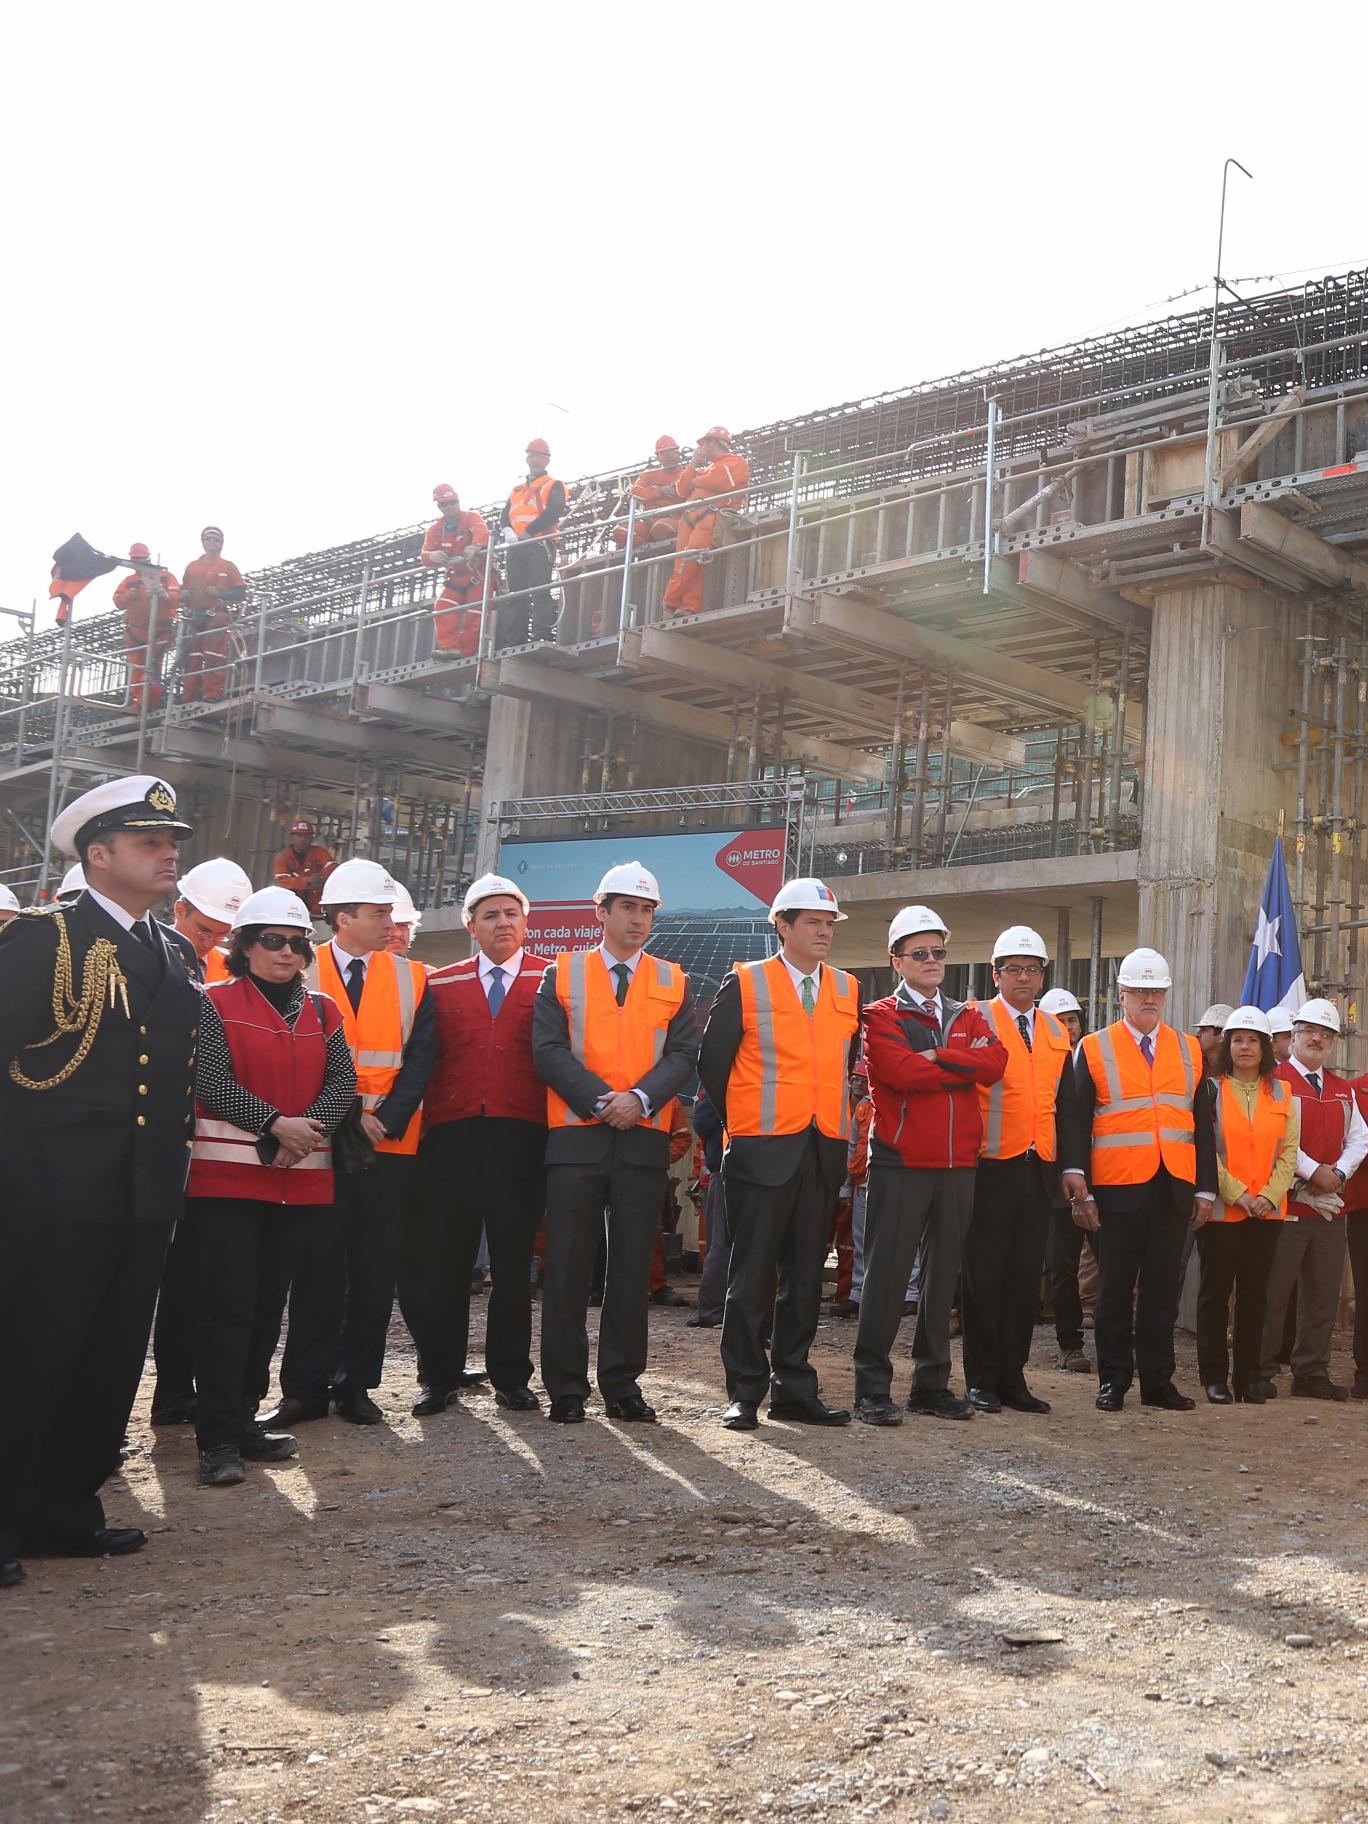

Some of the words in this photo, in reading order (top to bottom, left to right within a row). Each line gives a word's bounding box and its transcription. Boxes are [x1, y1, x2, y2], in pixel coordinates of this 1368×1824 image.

[743, 849, 781, 860] METRO
[543, 925, 571, 939] cada
[574, 925, 601, 940] viaje
